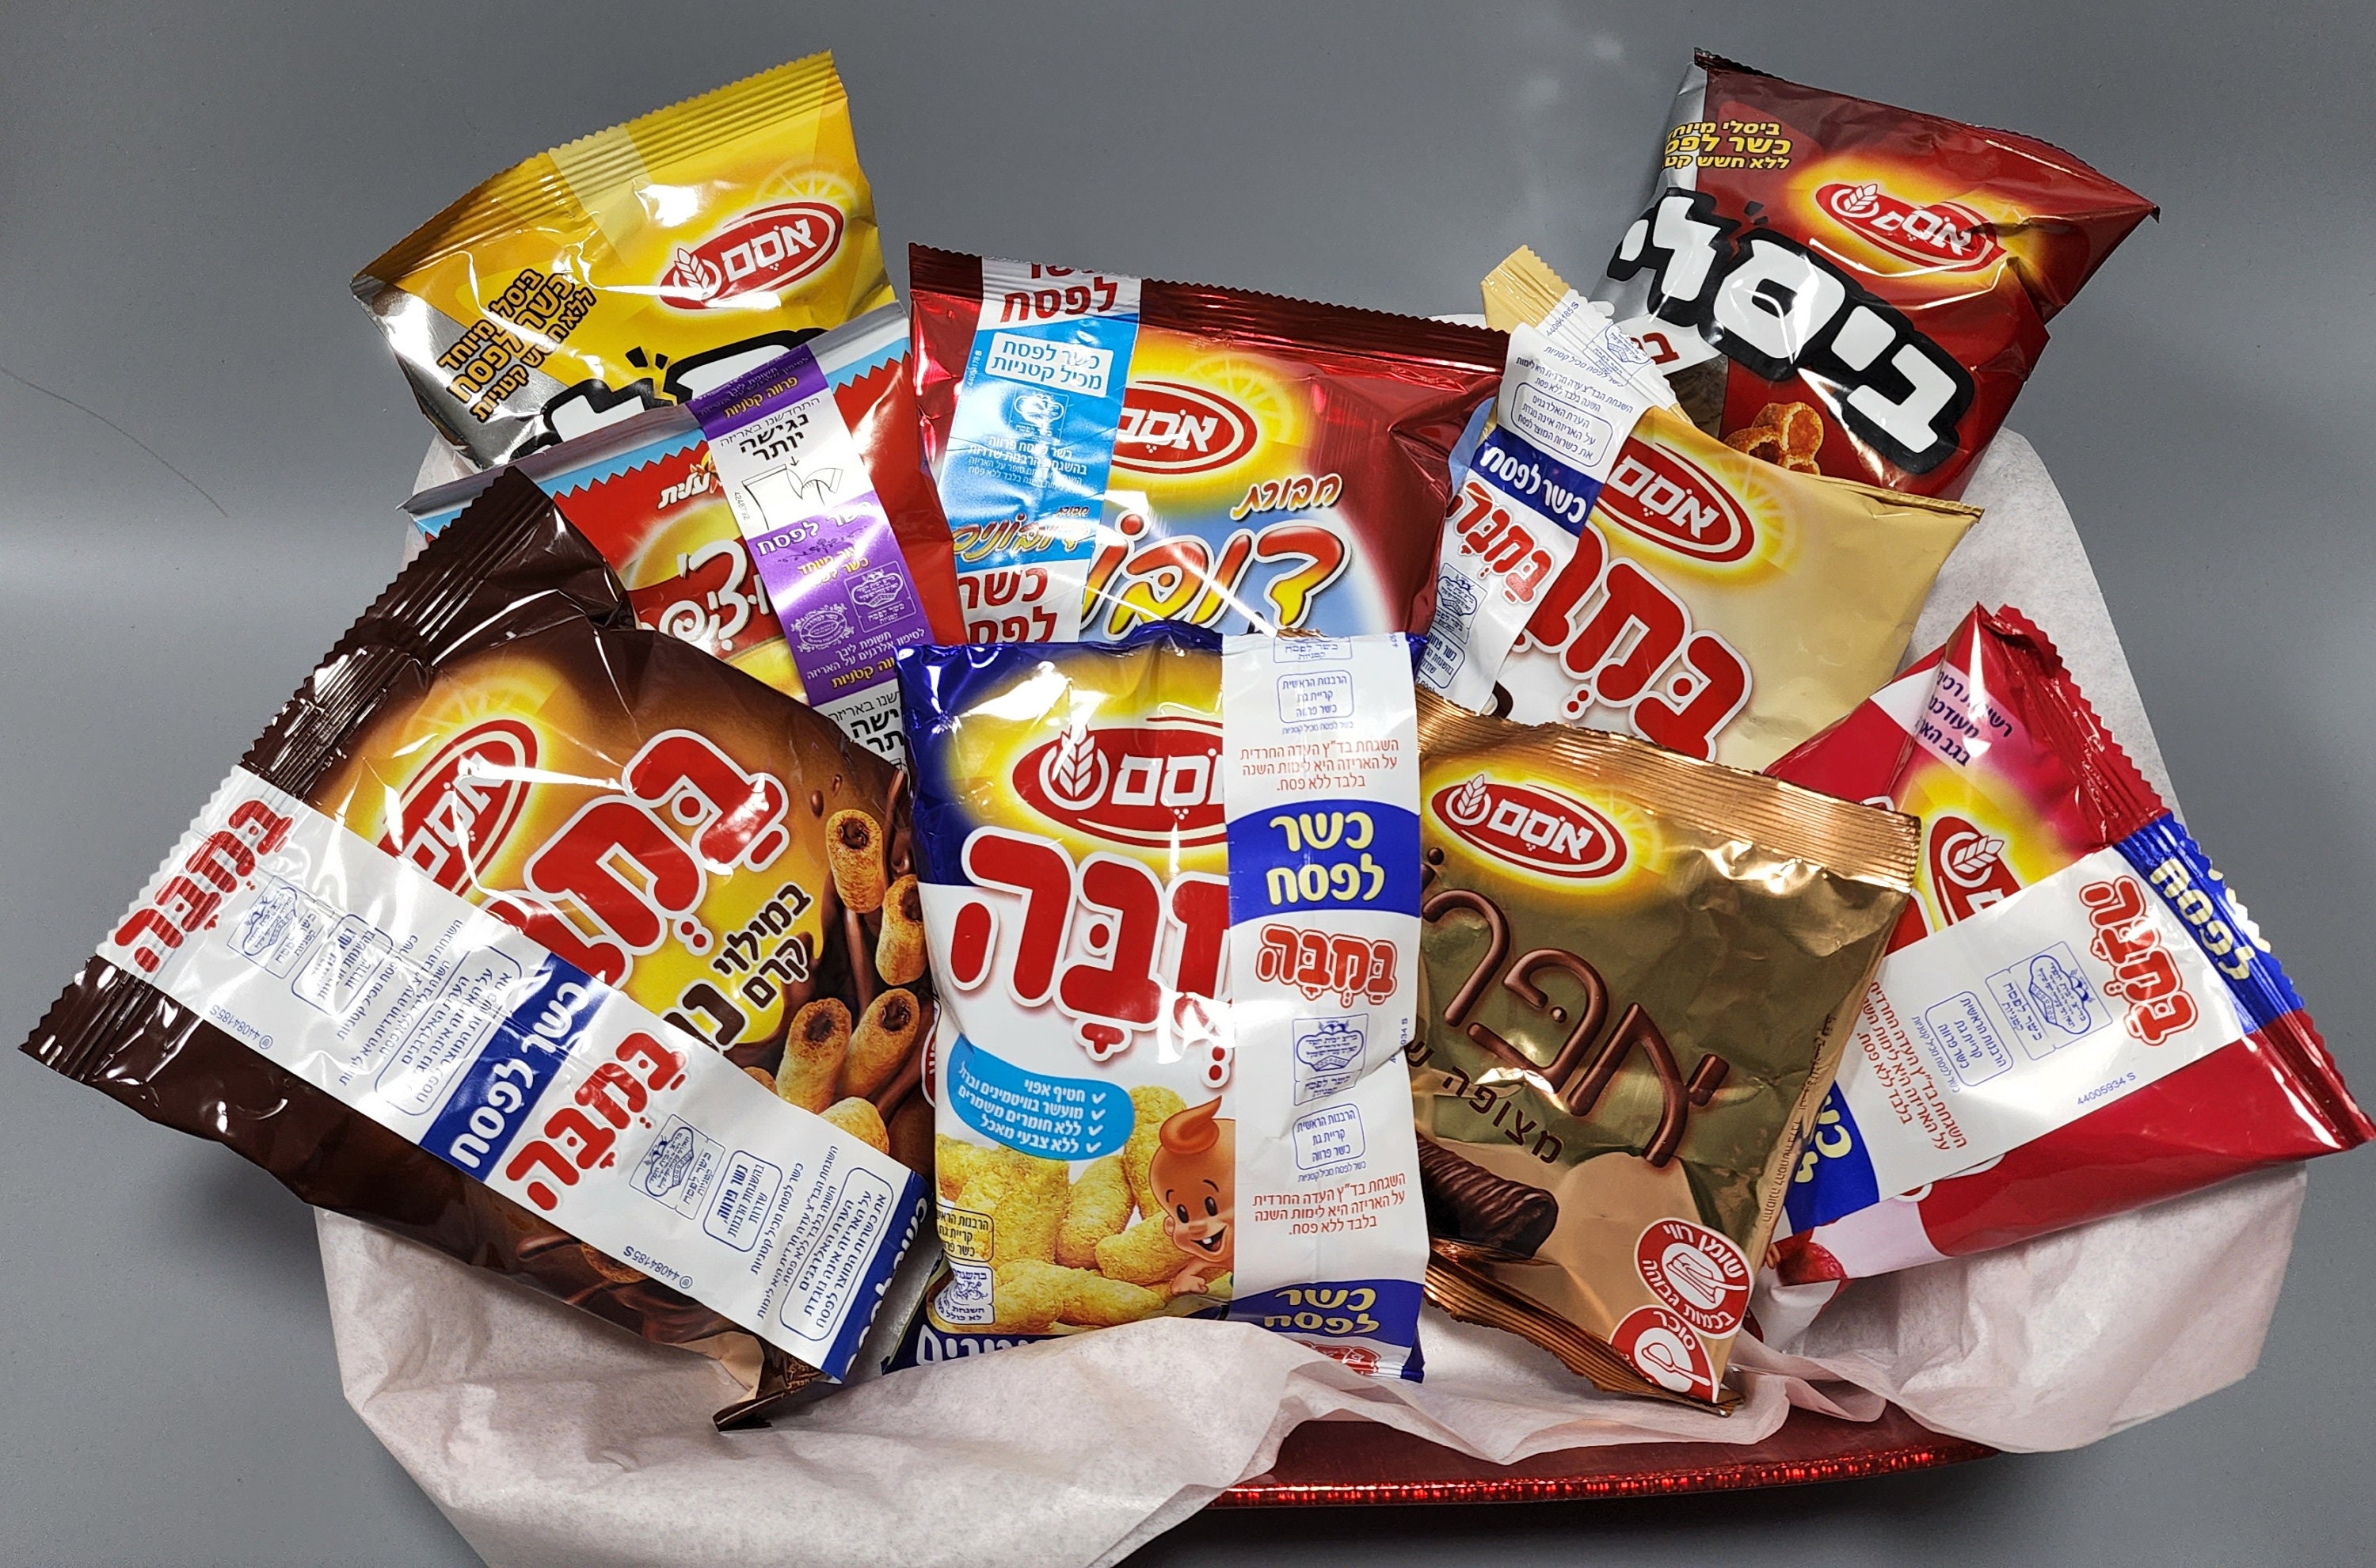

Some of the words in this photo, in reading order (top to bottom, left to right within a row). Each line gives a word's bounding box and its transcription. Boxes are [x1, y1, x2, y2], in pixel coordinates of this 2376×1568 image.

[1722, 120, 1781, 136] ביסלי
[1665, 133, 1721, 156] לפס
[1727, 135, 1793, 155] כשר
[1696, 155, 1746, 169] חשש
[1749, 157, 1792, 169] ללא
[489, 268, 544, 318] ביסל
[514, 272, 575, 330] כשר
[1000, 276, 1118, 322] לפסח
[560, 287, 597, 331] ללא
[1613, 192, 1966, 463] ביסלי
[436, 319, 497, 369] מיוחד
[1003, 339, 1057, 360] לפסח
[446, 329, 525, 403] לפסח
[991, 357, 1055, 382] קטניות
[764, 375, 799, 398] פרווה
[1060, 369, 1102, 390] מכיל
[469, 366, 529, 424] קטניות
[722, 392, 765, 420] קטניות
[1532, 394, 1566, 417] האלרגנים
[763, 397, 820, 426] התחדשנו
[1564, 411, 1590, 428] הערת
[719, 423, 763, 447] באריזה
[738, 413, 809, 453] נגישה
[752, 431, 804, 461] יותר
[1479, 445, 1542, 495] לפסח
[1543, 478, 1588, 524] כשר
[755, 518, 821, 557] לפסח
[958, 567, 1049, 610] כשר
[969, 607, 1058, 643] לפס
[805, 660, 841, 680] האריזה
[841, 653, 856, 667] על
[830, 664, 876, 689] קטניות
[1939, 737, 1970, 767] בגב
[1269, 811, 1375, 852] כשר
[1266, 852, 1385, 905] לפסח
[713, 881, 813, 980] במילוי
[2149, 857, 2256, 980] לפסח
[741, 938, 809, 1014] קרם
[520, 981, 590, 1054] כשר
[1959, 997, 1987, 1034] הראשית
[1871, 1026, 1900, 1060] לימות
[1892, 1029, 1919, 1066] העדה
[1936, 1022, 1958, 1049] פרווה
[1961, 1033, 1982, 1058] קריית
[1953, 1048, 1970, 1068] כשר
[1980, 1033, 2006, 1068] הרבנות
[1872, 1061, 1895, 1087] ללא
[1891, 1061, 1913, 1087] היא
[958, 1084, 1004, 1118] משמרים
[1024, 1079, 1051, 1097] אפוי
[1053, 1086, 1086, 1103] חטיף
[2077, 1079, 2126, 1106] 44005934
[2126, 1071, 2137, 1083] S
[448, 1058, 535, 1170] לפסח
[1042, 1101, 1084, 1120] מועשר
[1328, 1109, 1356, 1124] הרבנות
[1442, 1066, 1563, 1163] מצופה
[1887, 1088, 1913, 1125] בלבד
[1904, 1087, 1938, 1133] האריזה
[980, 1113, 1015, 1139] מאכל
[1005, 1109, 1053, 1132] חומרים
[1054, 1120, 1082, 1136] ללא
[1297, 1115, 1327, 1132] הראשית
[1931, 1101, 1967, 1148] השגחת
[1017, 1130, 1049, 1149] צבעי
[1051, 1136, 1079, 1154] ללא
[1326, 1128, 1346, 1143] קריית
[1931, 1131, 1950, 1150] על
[1334, 1144, 1351, 1156] כשר
[696, 1168, 716, 1197] קטניות
[729, 1163, 748, 1186] כשר
[741, 1163, 764, 1204] בהשגחת
[788, 1162, 804, 1182] כשר
[1368, 1172, 1406, 1189] השגחת
[748, 1191, 767, 1224] שדרות
[777, 1184, 794, 1212] לפסח
[820, 1185, 836, 1212] השנה
[857, 1189, 871, 1207] על
[873, 1193, 886, 1214] את
[1252, 1193, 1300, 1206] החרדית
[1303, 1189, 1335, 1205] העדה
[1327, 1202, 1348, 1216] היא
[1350, 1195, 1390, 1212] האריזה
[1392, 1189, 1406, 1205] על
[726, 1203, 748, 1238] הרבנות
[765, 1212, 783, 1237] מכיל
[805, 1212, 825, 1238] בלבד
[832, 1199, 854, 1234] הערת
[959, 1216, 989, 1231] הרבנות
[1255, 1209, 1289, 1222] השנה
[1291, 1205, 1326, 1220] לימות
[1321, 1218, 1345, 1233] ללא
[1347, 1214, 1377, 1229] בלבד
[836, 1208, 866, 1250] האריזה
[853, 1213, 878, 1254] כשרות
[950, 1230, 973, 1244] קריית
[1662, 1223, 1694, 1243] רווי
[750, 1238, 774, 1275] קטניות
[793, 1239, 809, 1260] ללא
[798, 1234, 835, 1291] האלרגנים
[958, 1245, 975, 1258] כשר
[1698, 1235, 1745, 1279] שומן
[822, 1250, 842, 1280] אינה
[833, 1254, 858, 1289] המוצר
[803, 1280, 828, 1316] נוגדת
[815, 1292, 838, 1328] לפסח
[1274, 1288, 1376, 1311] כשר
[1263, 1313, 1380, 1334] לפסח
[1683, 1305, 1735, 1330] בכמות
[1654, 1311, 1696, 1351] סוכר
